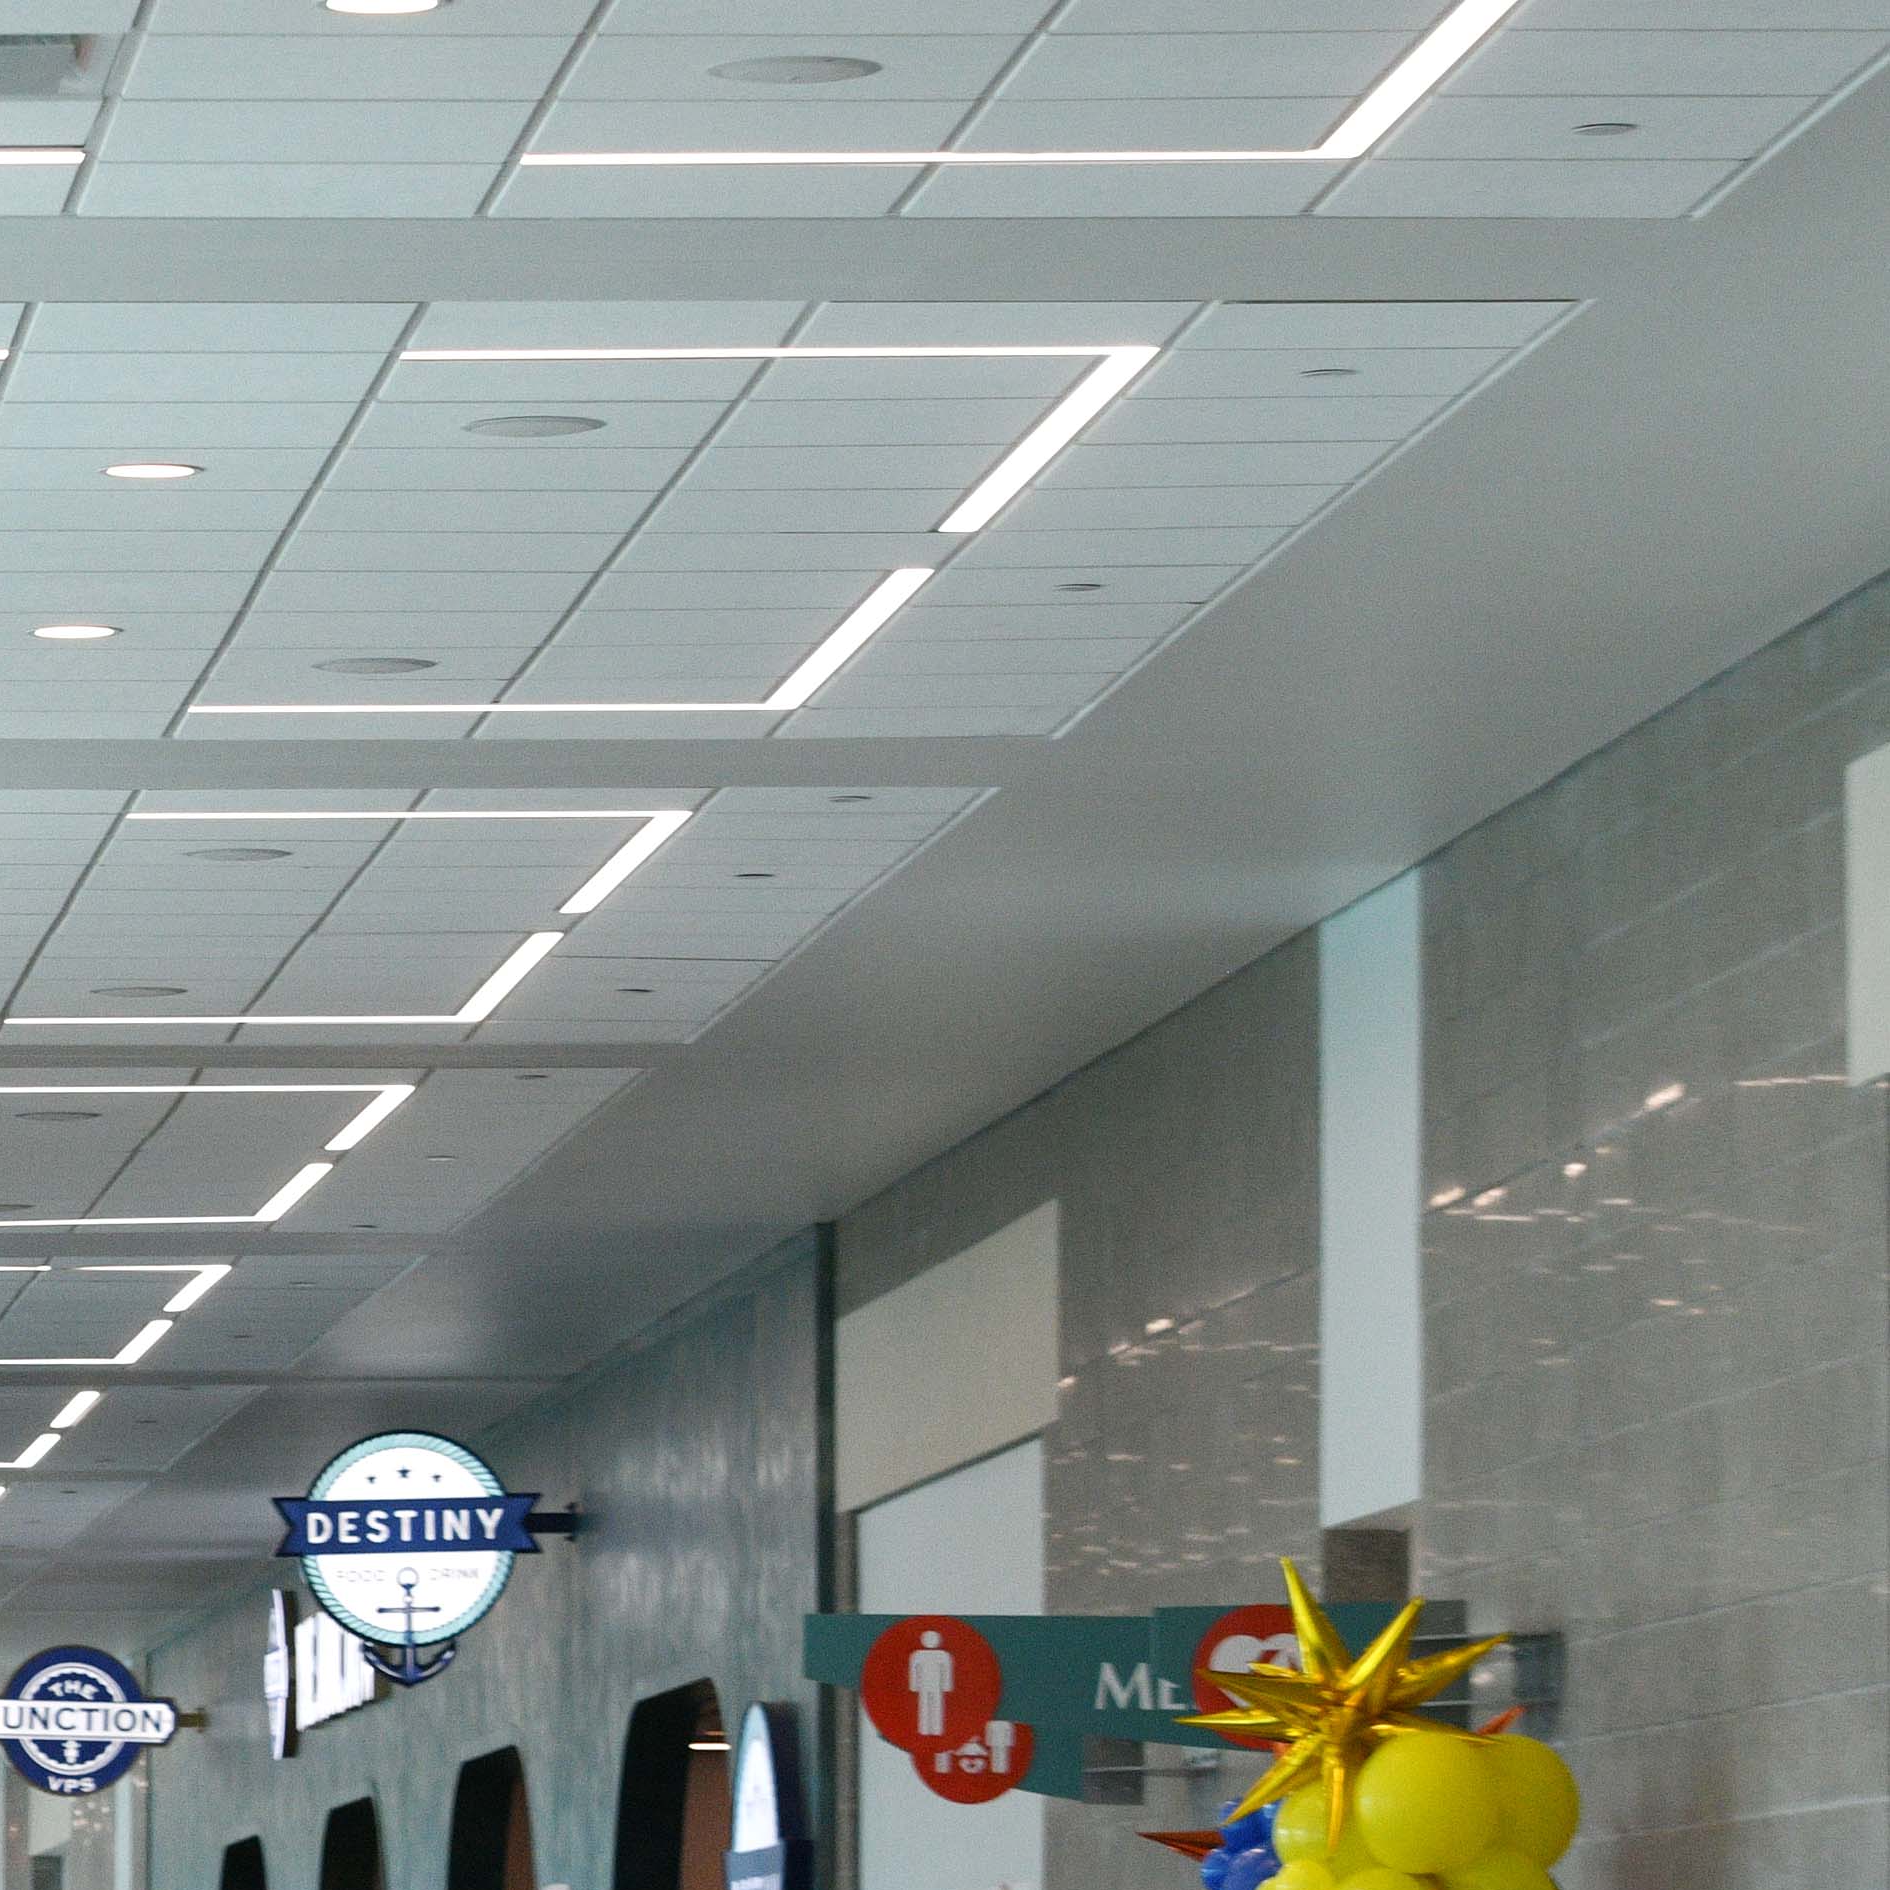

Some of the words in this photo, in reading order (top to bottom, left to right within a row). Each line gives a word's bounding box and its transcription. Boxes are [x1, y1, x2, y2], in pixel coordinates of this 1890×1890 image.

[306, 1508, 505, 1544] DESTINY
[47, 1679, 100, 1700] THE
[1094, 1662, 1201, 1710] ME
[47, 1775, 97, 1793] VPS
